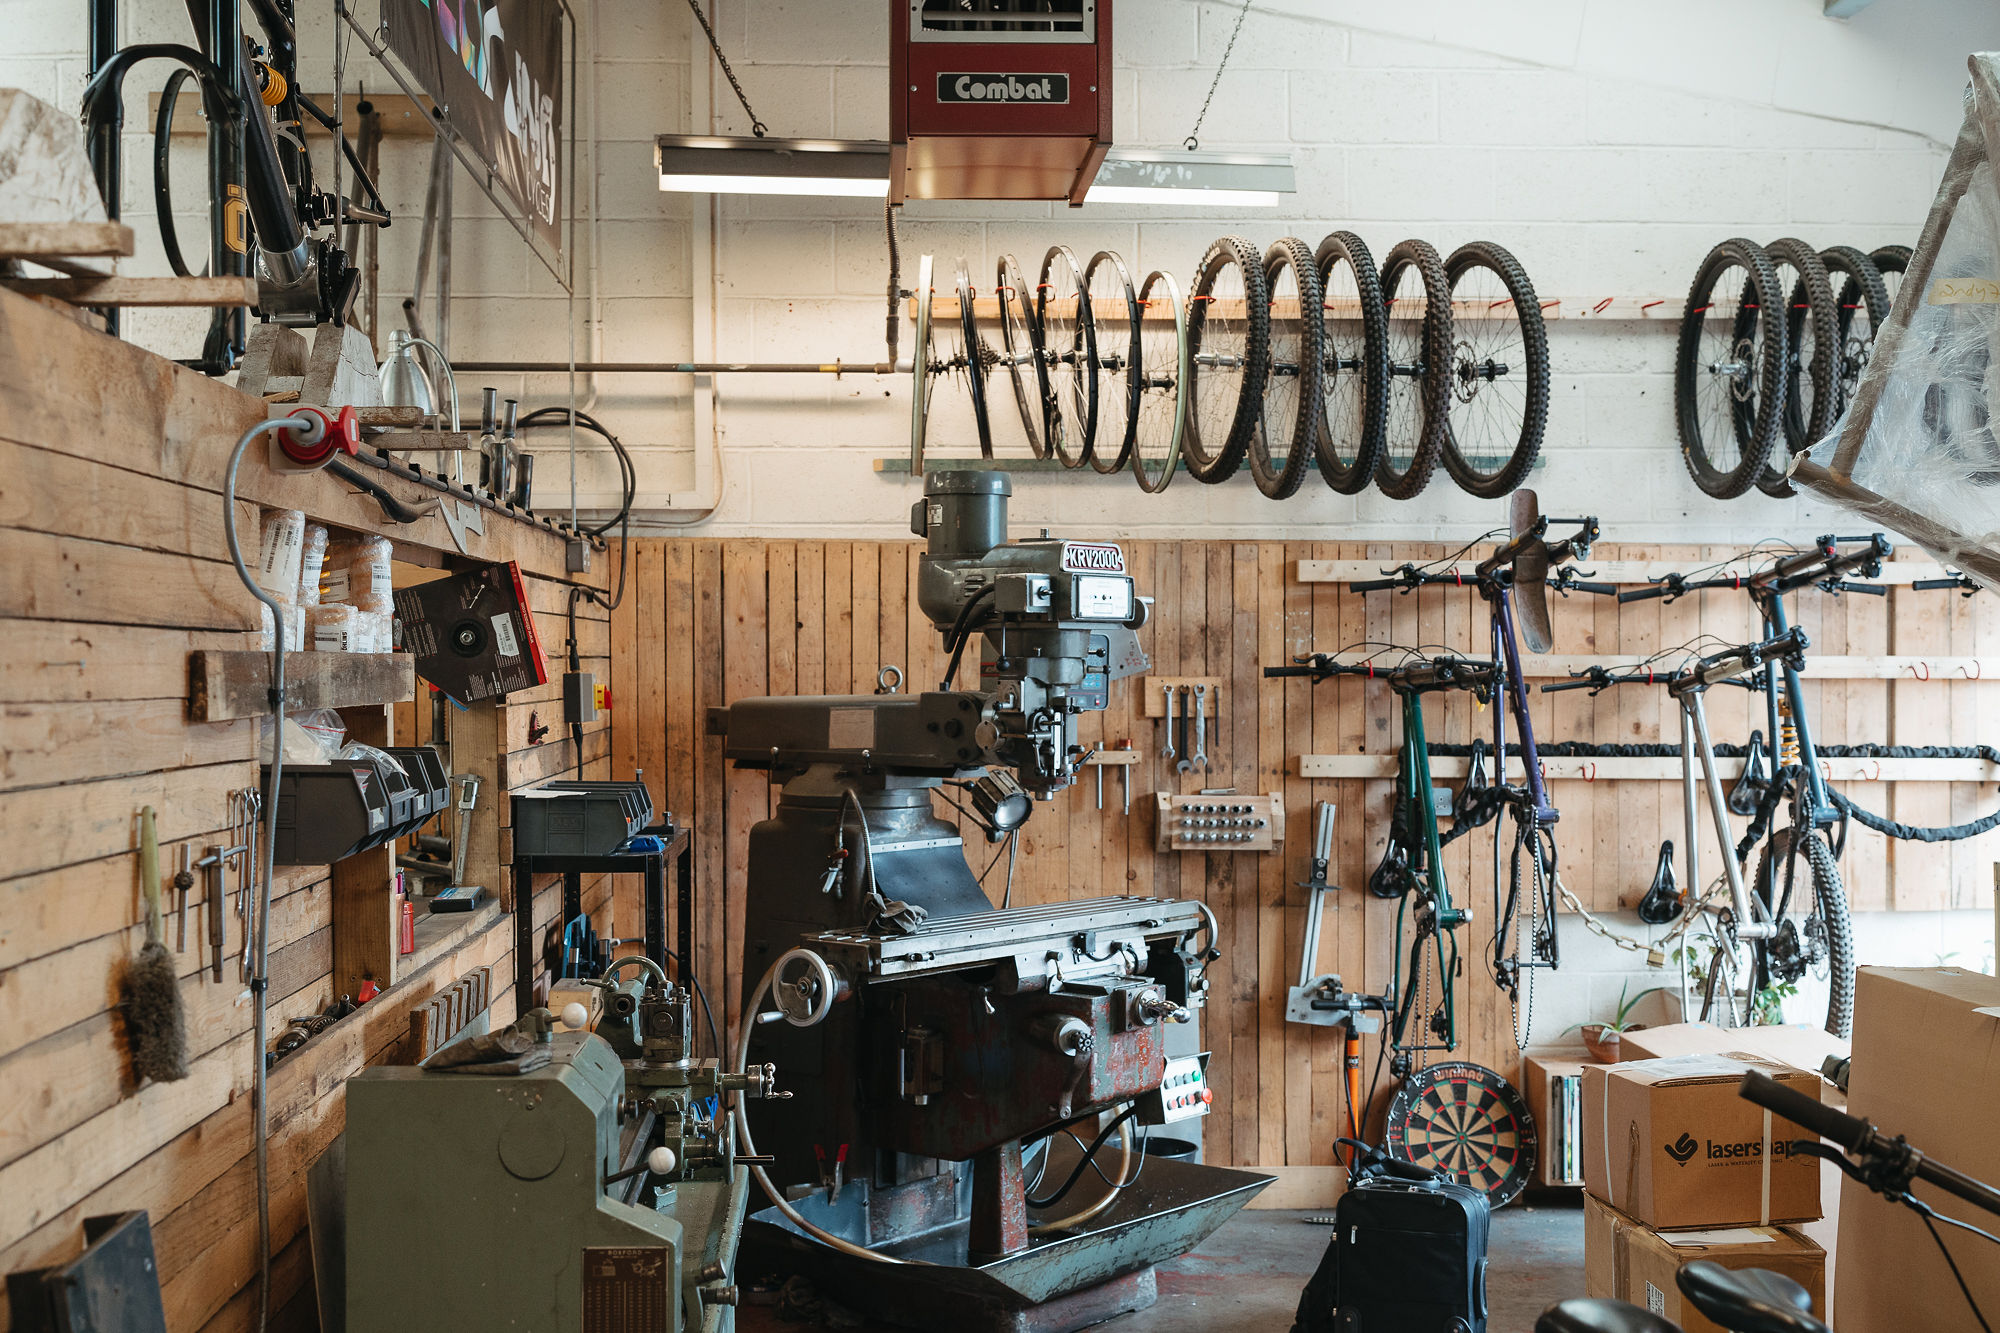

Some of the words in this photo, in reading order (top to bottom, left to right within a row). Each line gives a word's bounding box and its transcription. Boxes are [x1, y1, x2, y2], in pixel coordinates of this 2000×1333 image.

[954, 75, 1051, 100] Combat
[1068, 548, 1119, 569] KRV2000
[1706, 1136, 1794, 1159] lasersap
